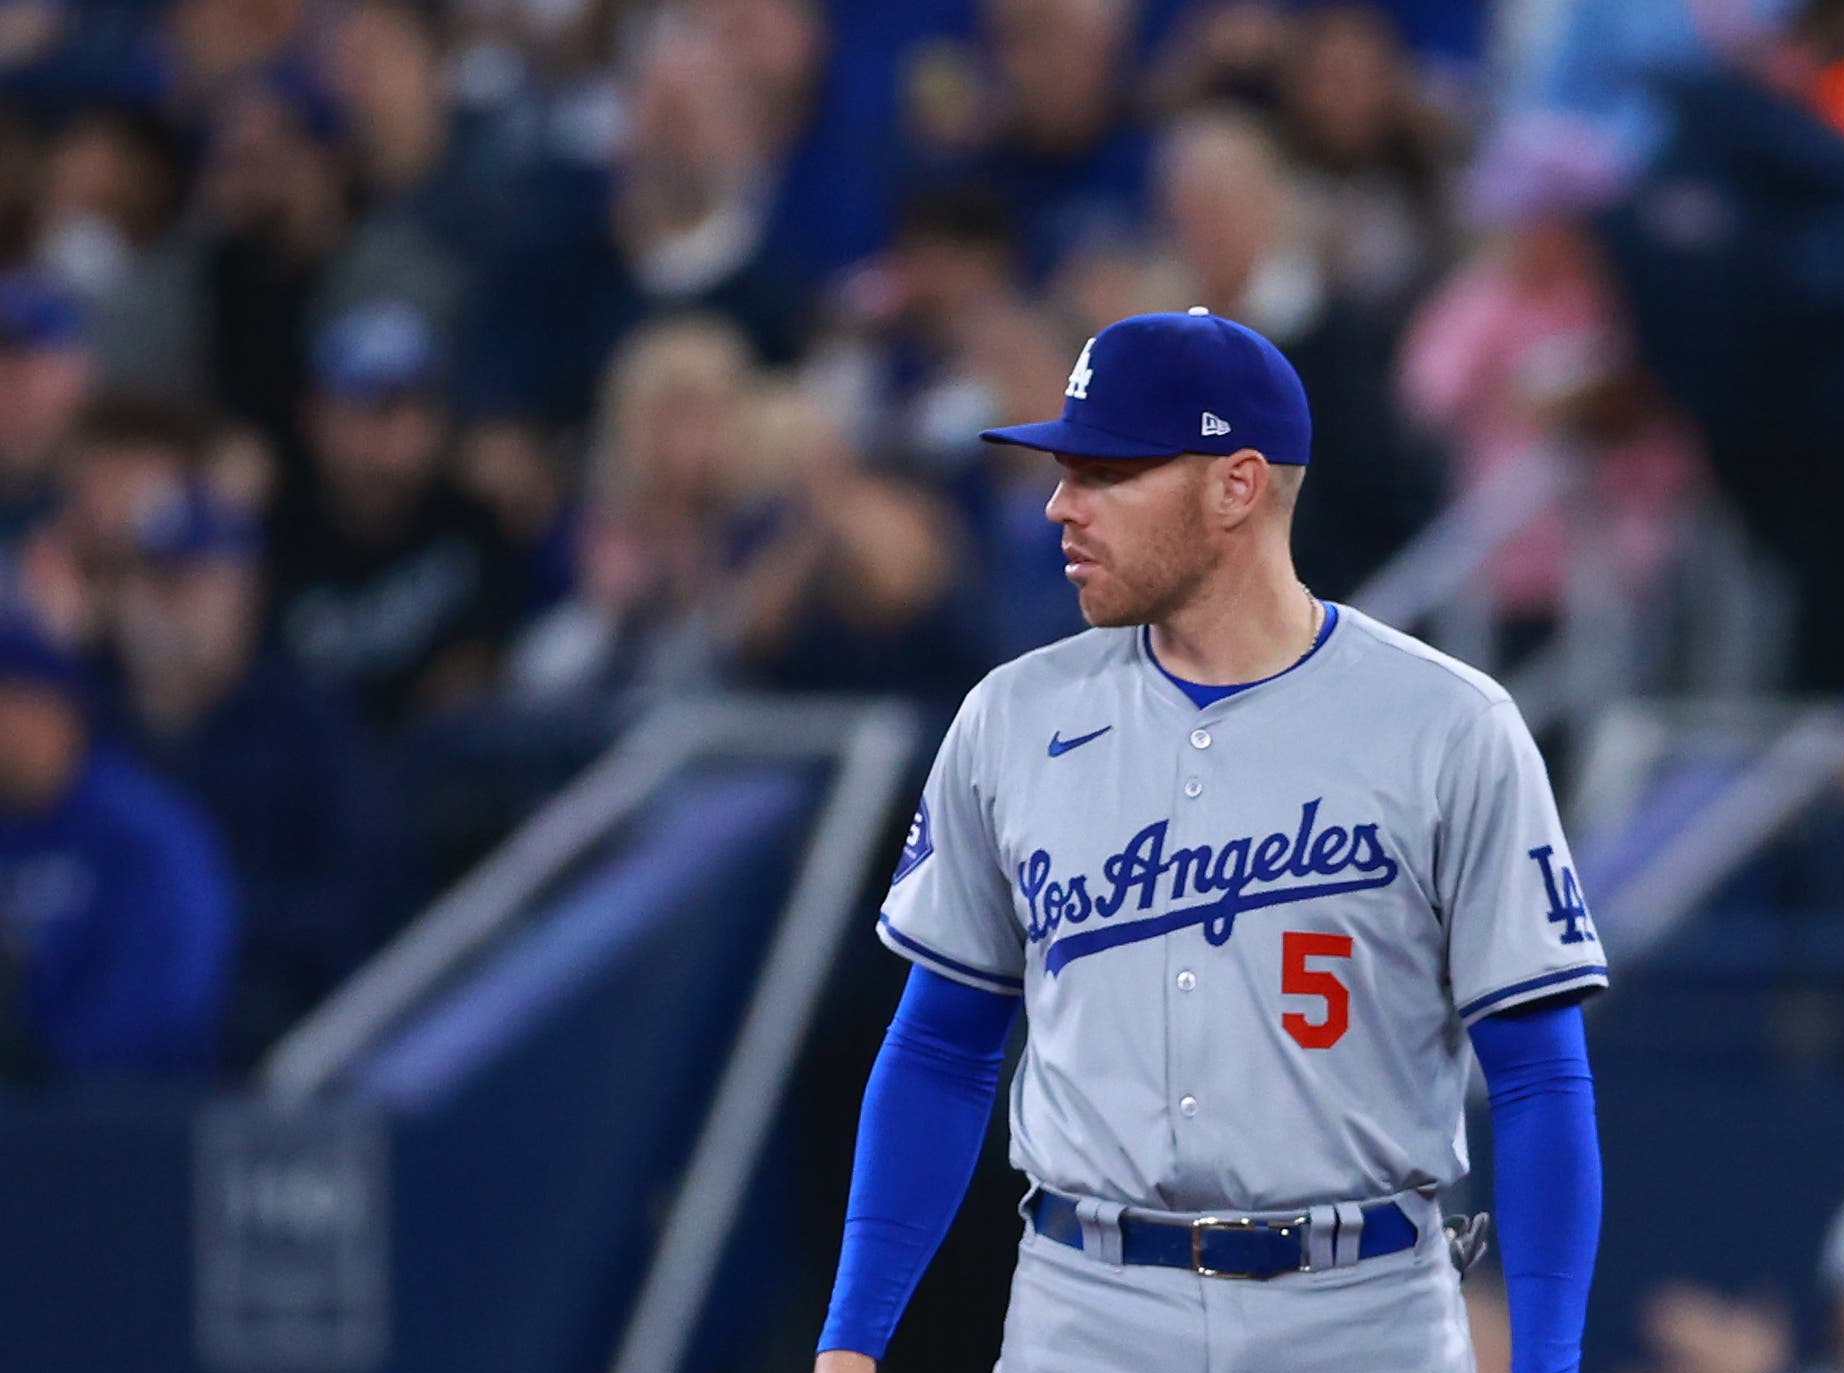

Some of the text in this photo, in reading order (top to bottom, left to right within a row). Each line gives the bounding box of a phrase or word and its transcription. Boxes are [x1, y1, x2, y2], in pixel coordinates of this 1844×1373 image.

[1018, 797, 1398, 947] Los Angeles
[1528, 844, 1595, 944] LA
[1281, 931, 1353, 1049] 5
